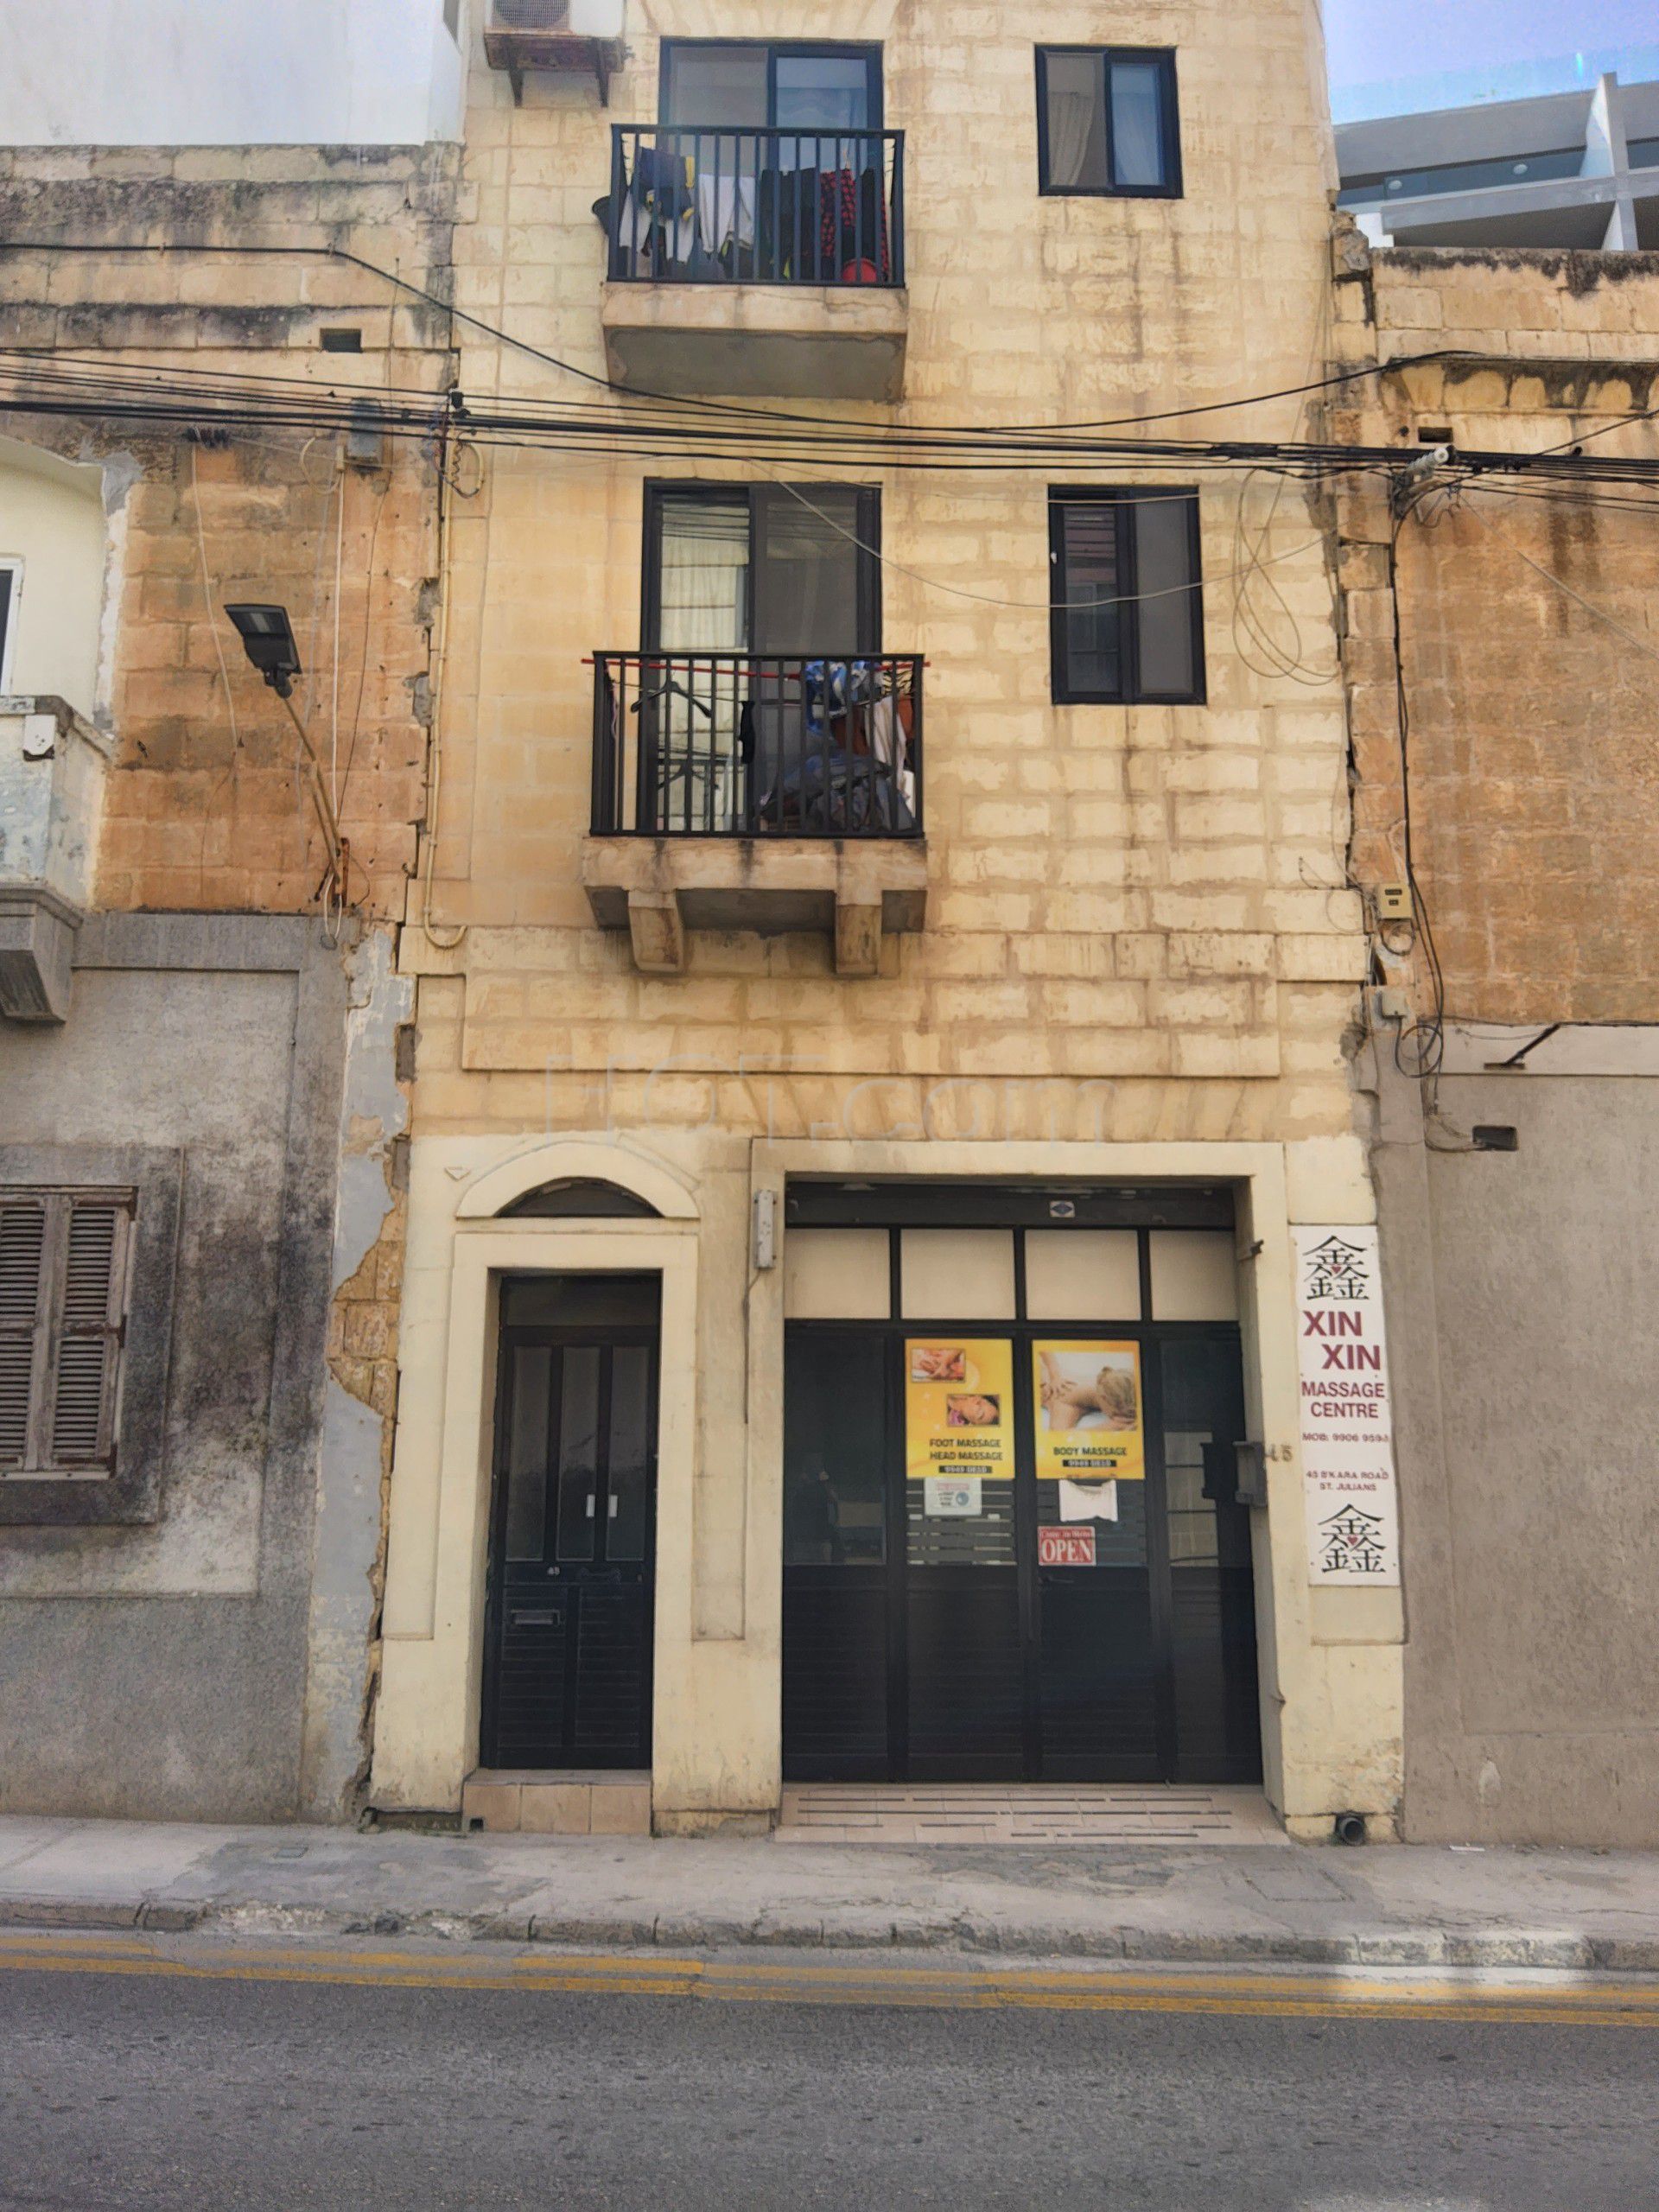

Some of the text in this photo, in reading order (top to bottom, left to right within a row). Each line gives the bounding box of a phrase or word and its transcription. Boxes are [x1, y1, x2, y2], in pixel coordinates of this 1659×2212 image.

[1303, 1311, 1363, 1337] XIN
[1321, 1344, 1381, 1370] XIN
[1301, 1381, 1385, 1398] MASSAGE
[1311, 1402, 1379, 1419] CENTRE
[929, 1438, 1001, 1447] FOOT MASSAGE
[1053, 1446, 1128, 1456] BODY MASSAGE
[929, 1451, 1003, 1461] HEAD MASSAGE
[1360, 1471, 1389, 1480] ROAD
[1041, 1538, 1092, 1562] OPEN
